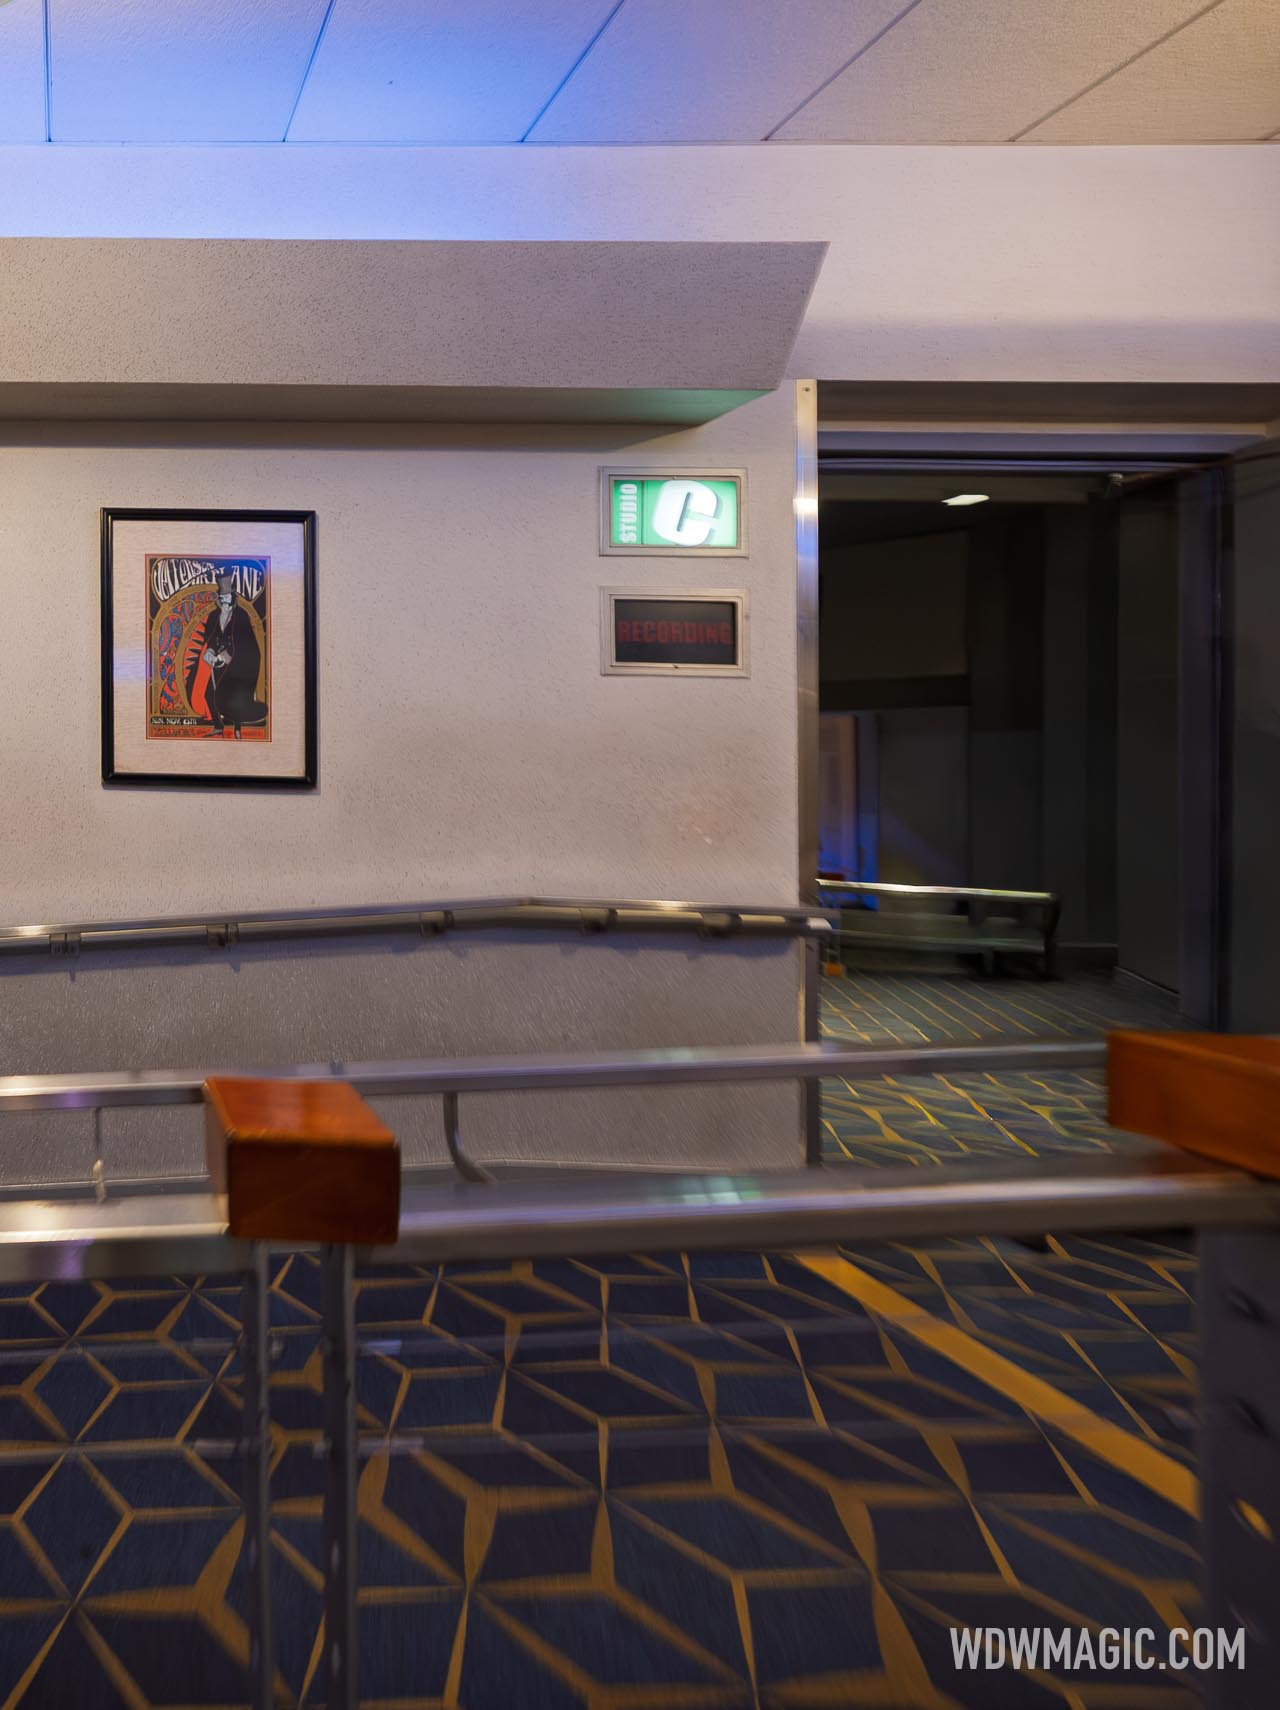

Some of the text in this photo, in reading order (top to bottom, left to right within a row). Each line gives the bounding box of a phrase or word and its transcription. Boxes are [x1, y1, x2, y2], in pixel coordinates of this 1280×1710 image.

[619, 480, 720, 546] STUDIO C
[617, 619, 734, 645] RECORDING
